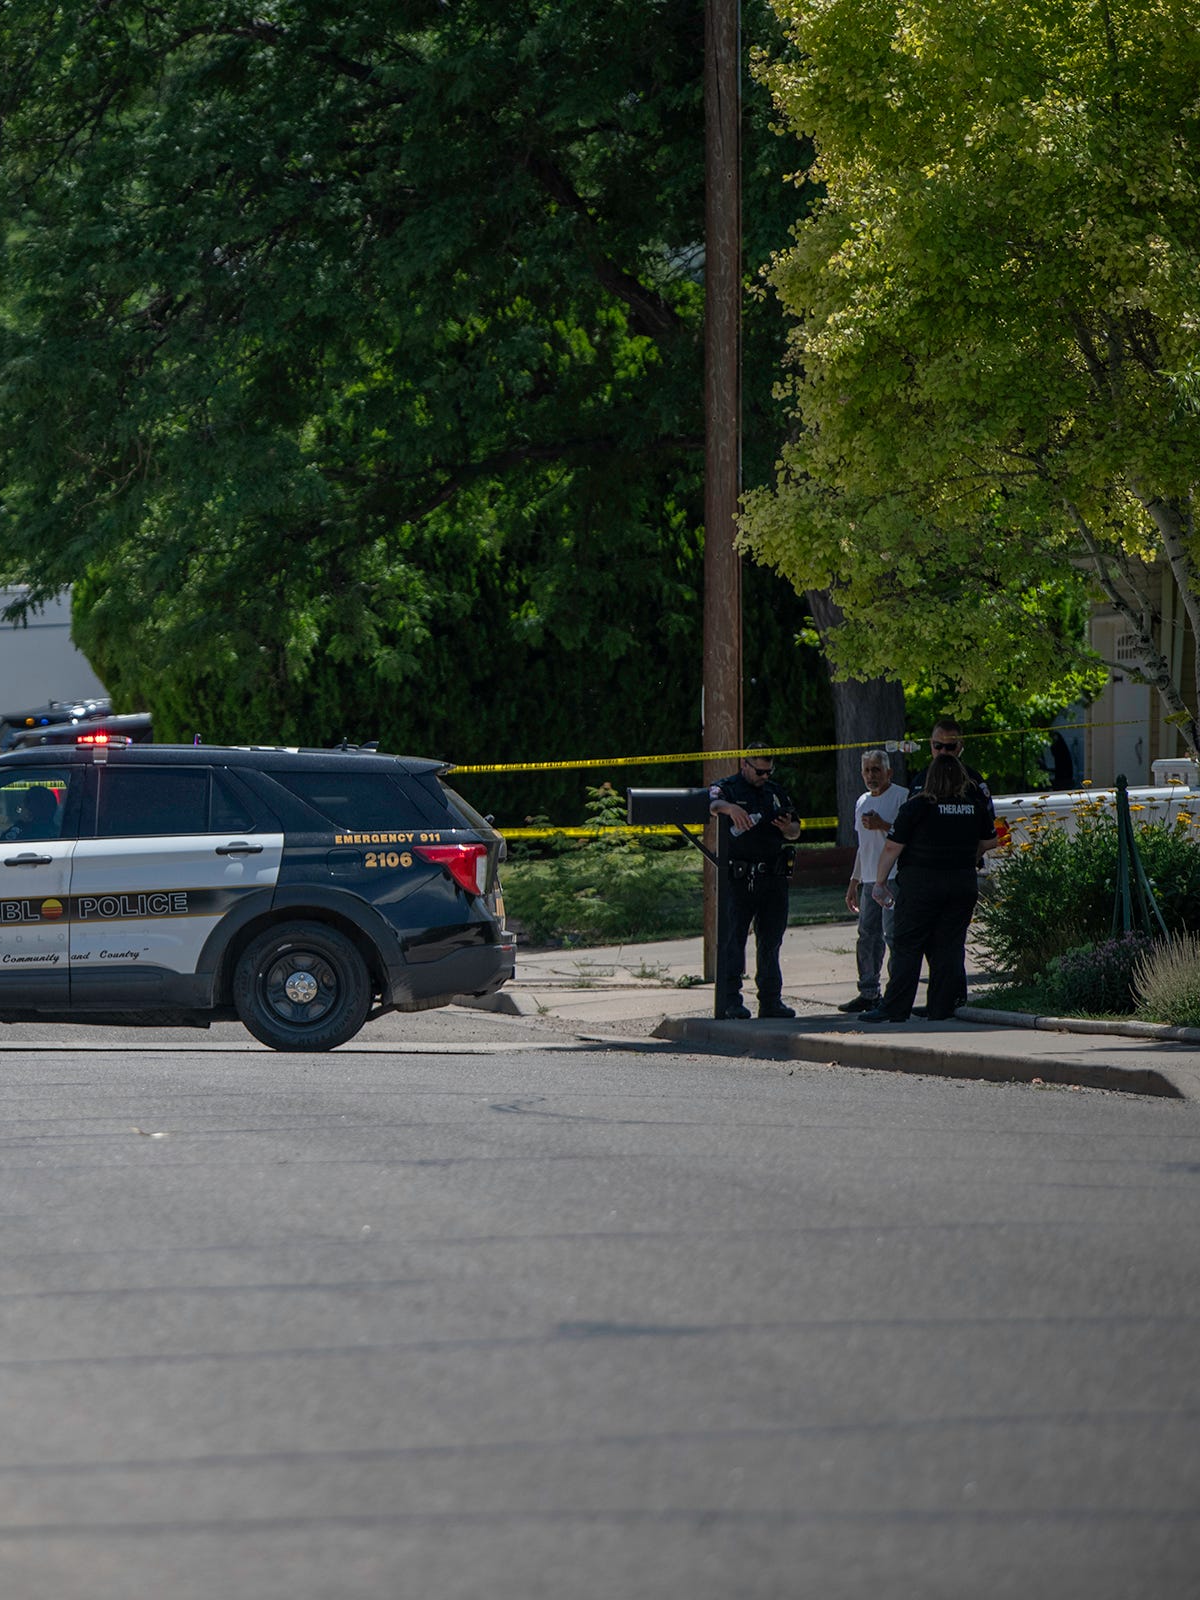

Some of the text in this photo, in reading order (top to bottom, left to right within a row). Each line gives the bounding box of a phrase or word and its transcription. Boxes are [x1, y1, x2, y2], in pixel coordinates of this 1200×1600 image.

[938, 804, 974, 815] THERAPIST
[335, 832, 441, 844] EMERGENCY 911
[364, 852, 413, 868] 2106
[78, 892, 189, 919] POLICE
[70, 952, 91, 960] and
